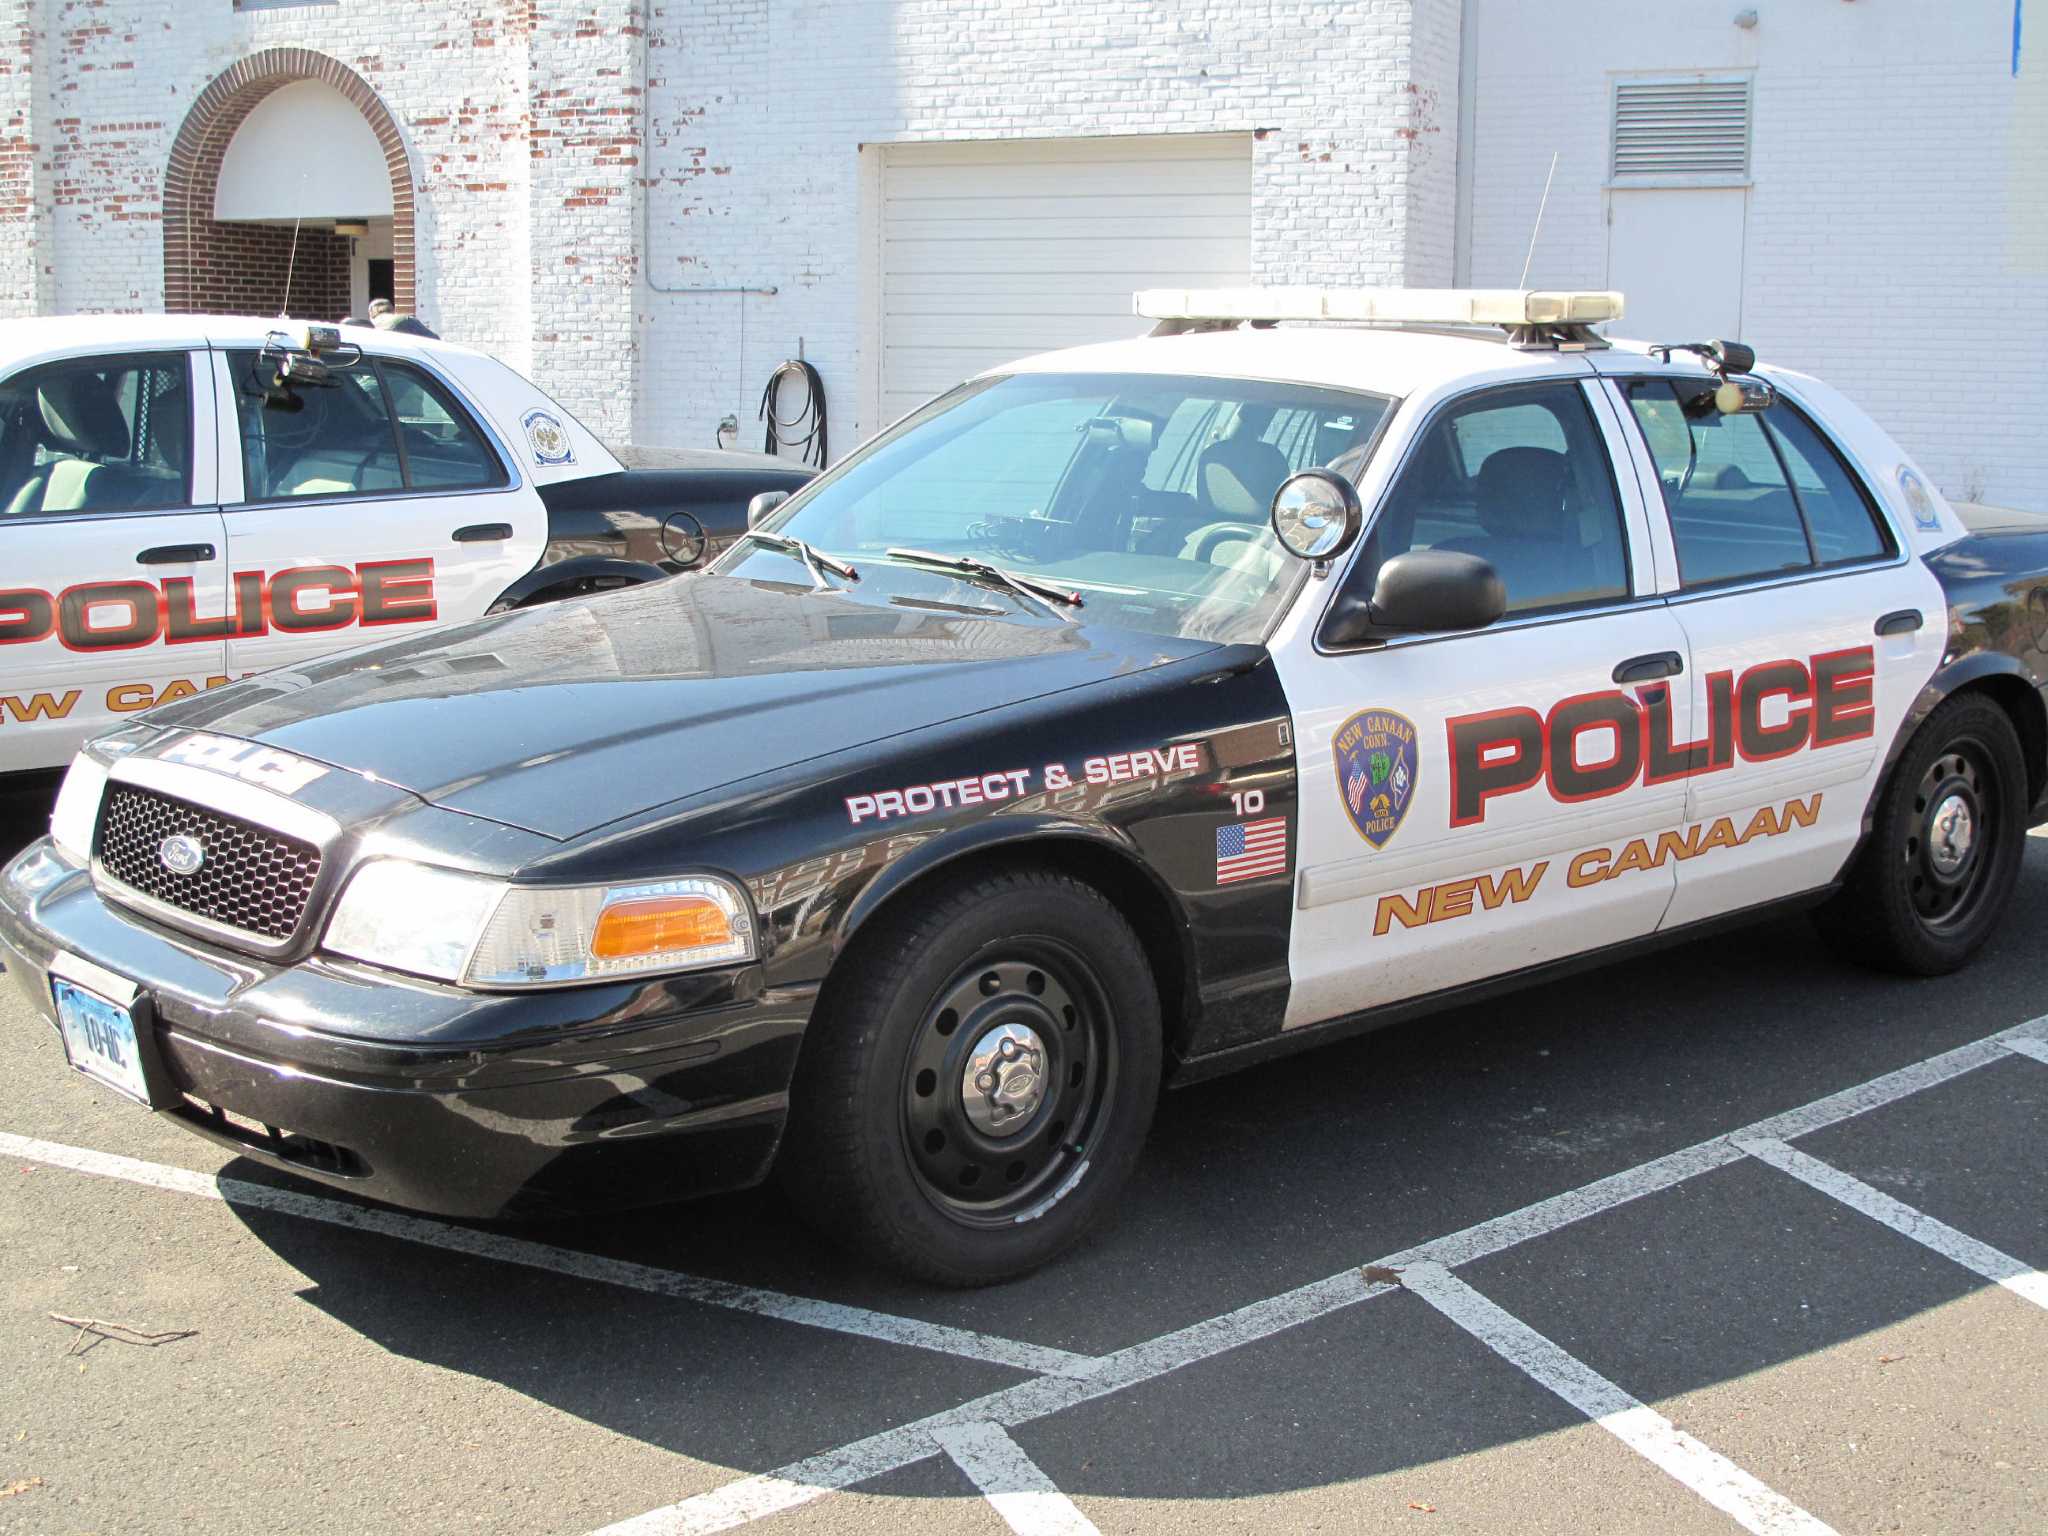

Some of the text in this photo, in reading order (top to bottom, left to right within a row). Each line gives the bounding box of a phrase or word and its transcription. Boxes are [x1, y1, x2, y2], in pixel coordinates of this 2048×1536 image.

[1338, 716, 1413, 753] NEW CANAAN
[1446, 645, 1875, 828] POLICE
[845, 743, 1201, 824] PROTECT & SERVE
[1231, 790, 1265, 816] 10
[1366, 817, 1395, 834] POLICE
[1372, 793, 1823, 936] NEW CANAAN
